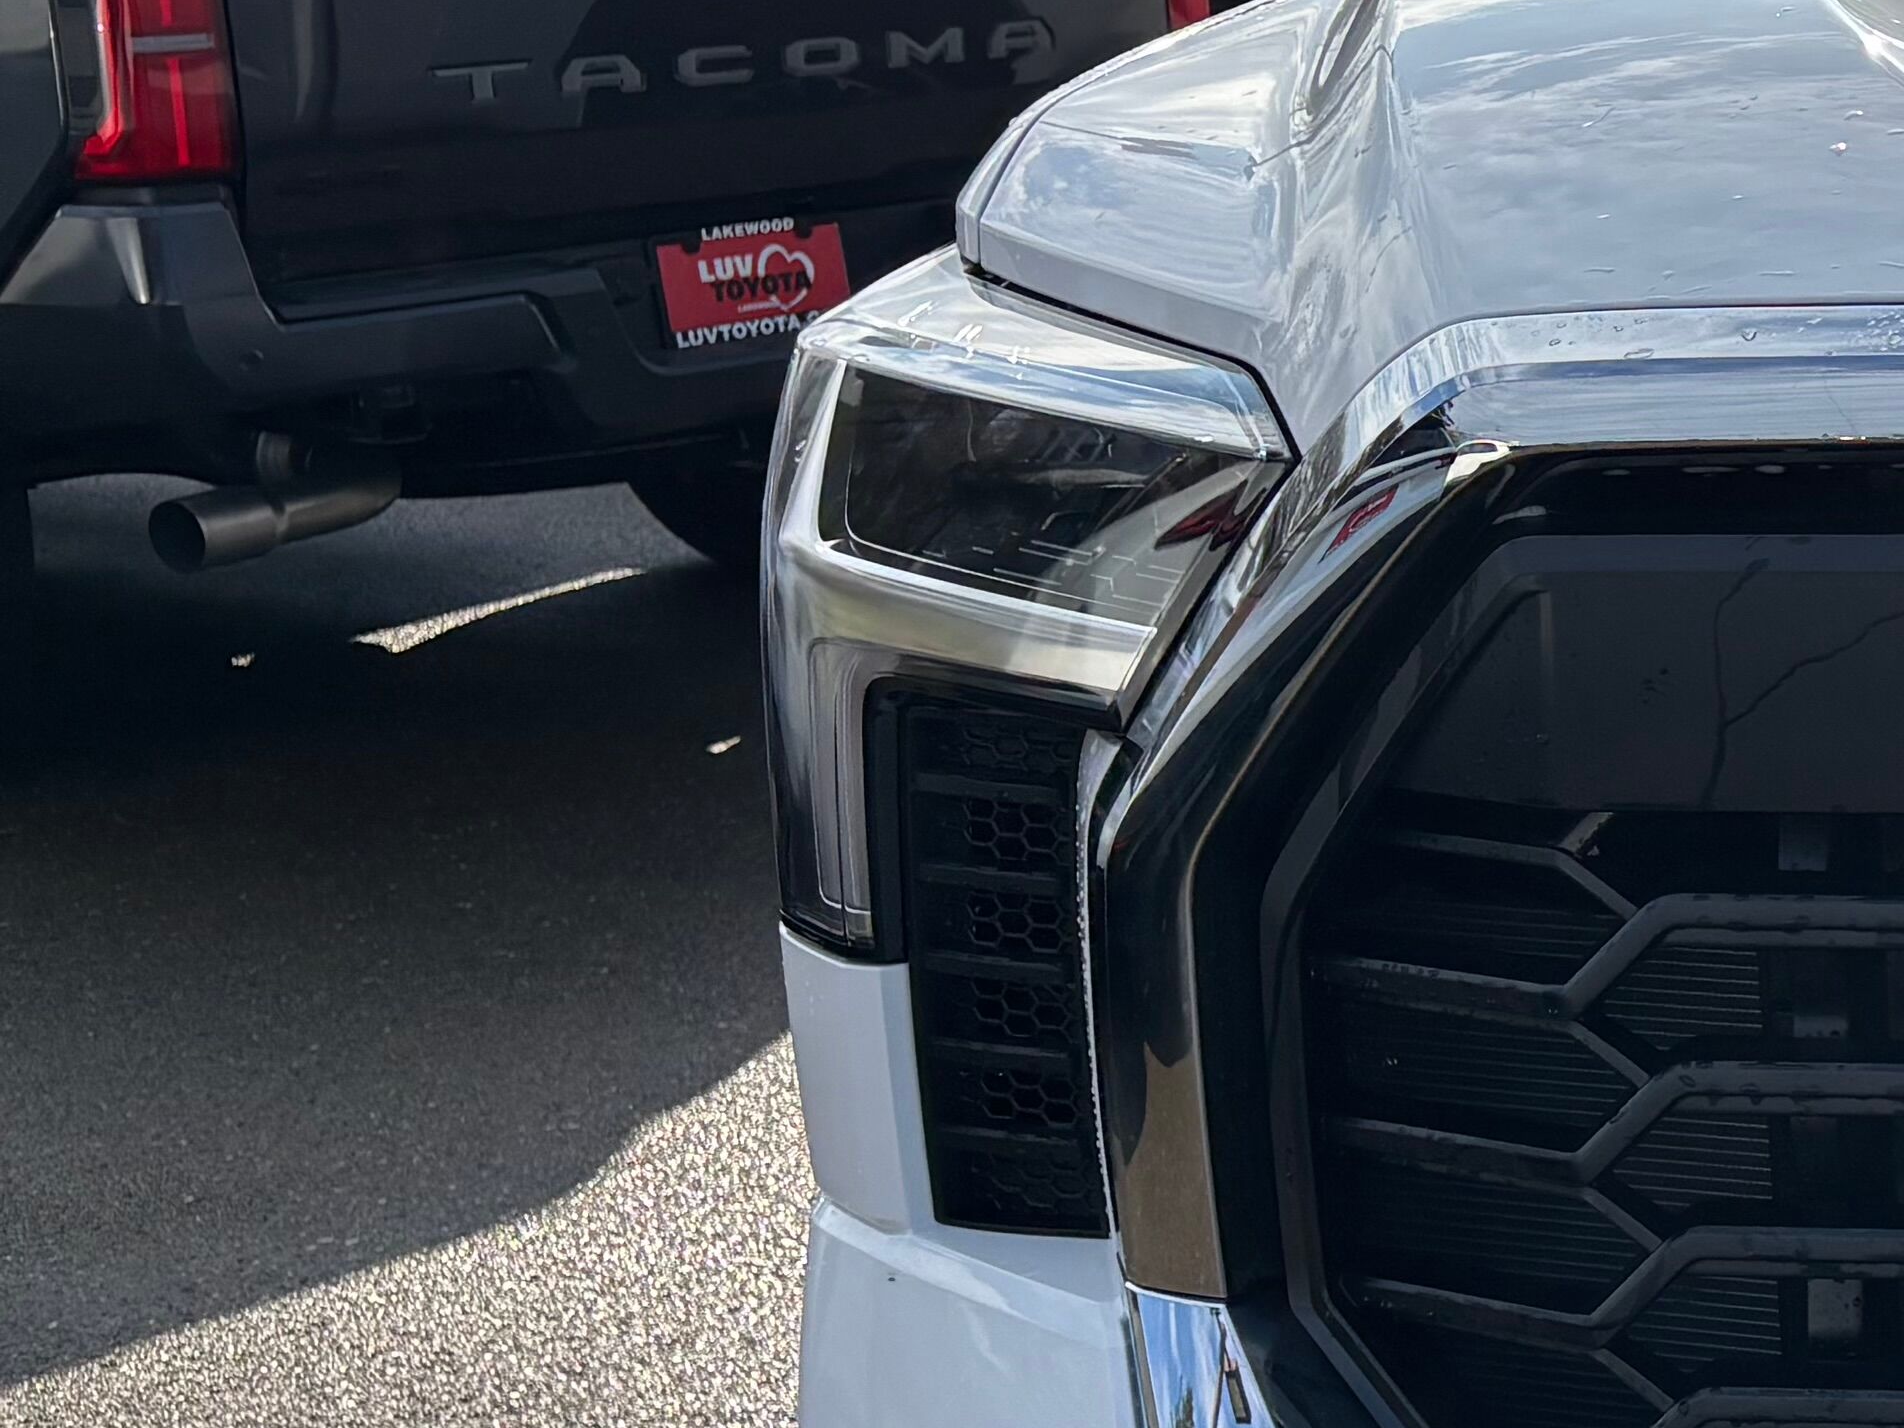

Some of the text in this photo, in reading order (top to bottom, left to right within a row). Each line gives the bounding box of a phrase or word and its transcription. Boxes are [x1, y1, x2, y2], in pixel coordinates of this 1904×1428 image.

[433, 16, 1055, 104] TACOMA
[701, 217, 794, 241] LAKEWOOD
[698, 254, 753, 283] LUV
[711, 272, 812, 302] TOYOTA
